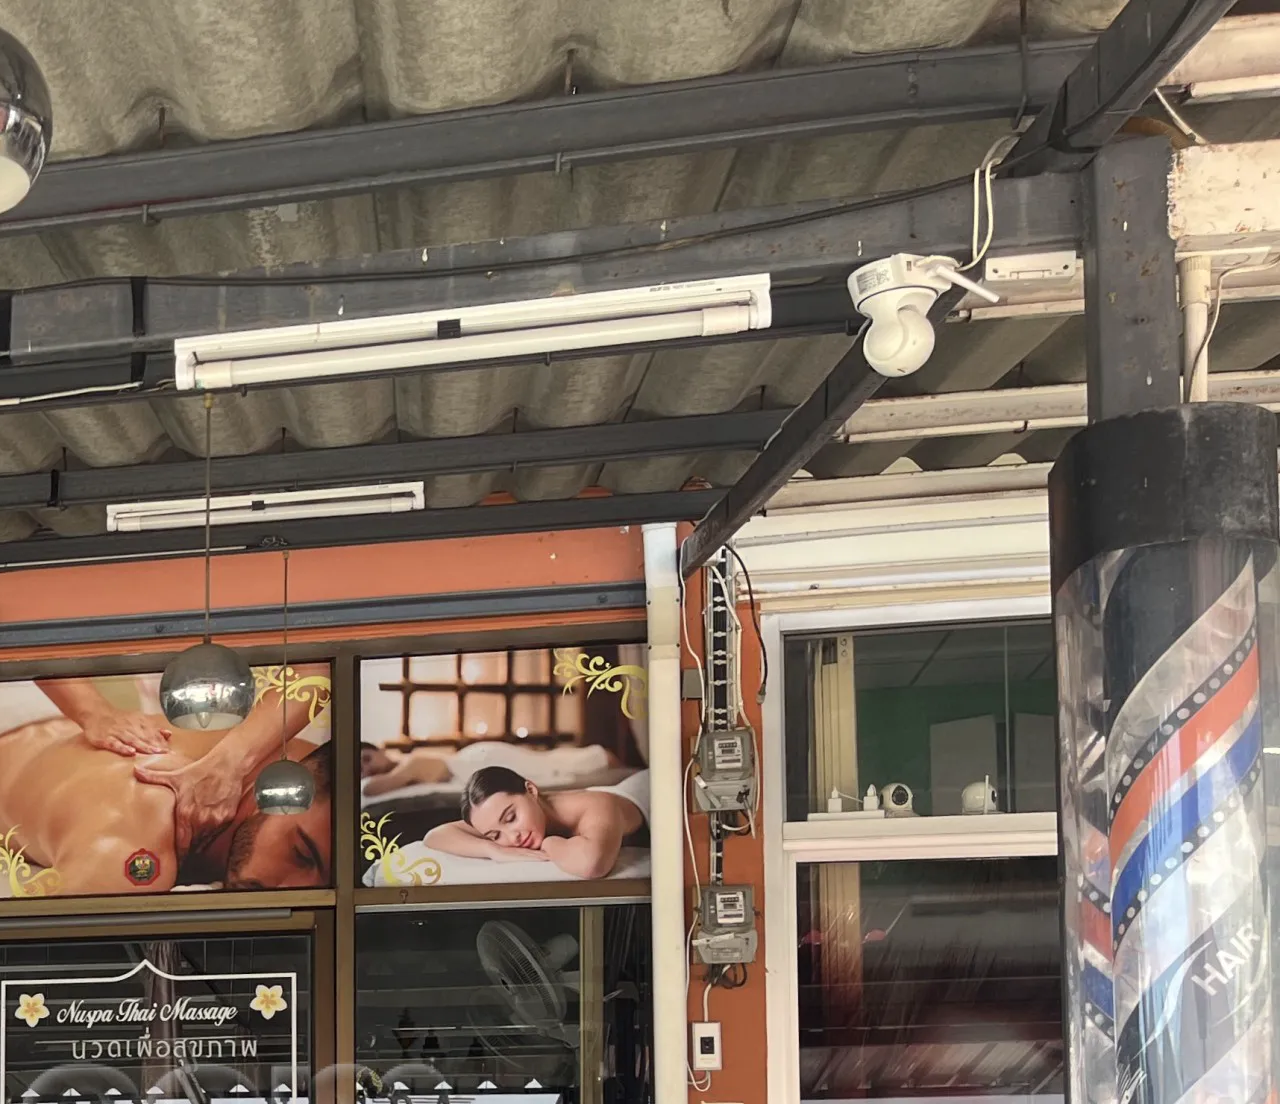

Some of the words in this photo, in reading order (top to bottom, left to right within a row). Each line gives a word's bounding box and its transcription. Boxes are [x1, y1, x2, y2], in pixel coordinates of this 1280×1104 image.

[1190, 922, 1261, 997] HAIR
[56, 999, 115, 1029] Nuspa
[114, 999, 158, 1023] Thai
[158, 997, 239, 1027] Massage
[70, 1026, 258, 1067] นวดเพื่อสุขภาพ
